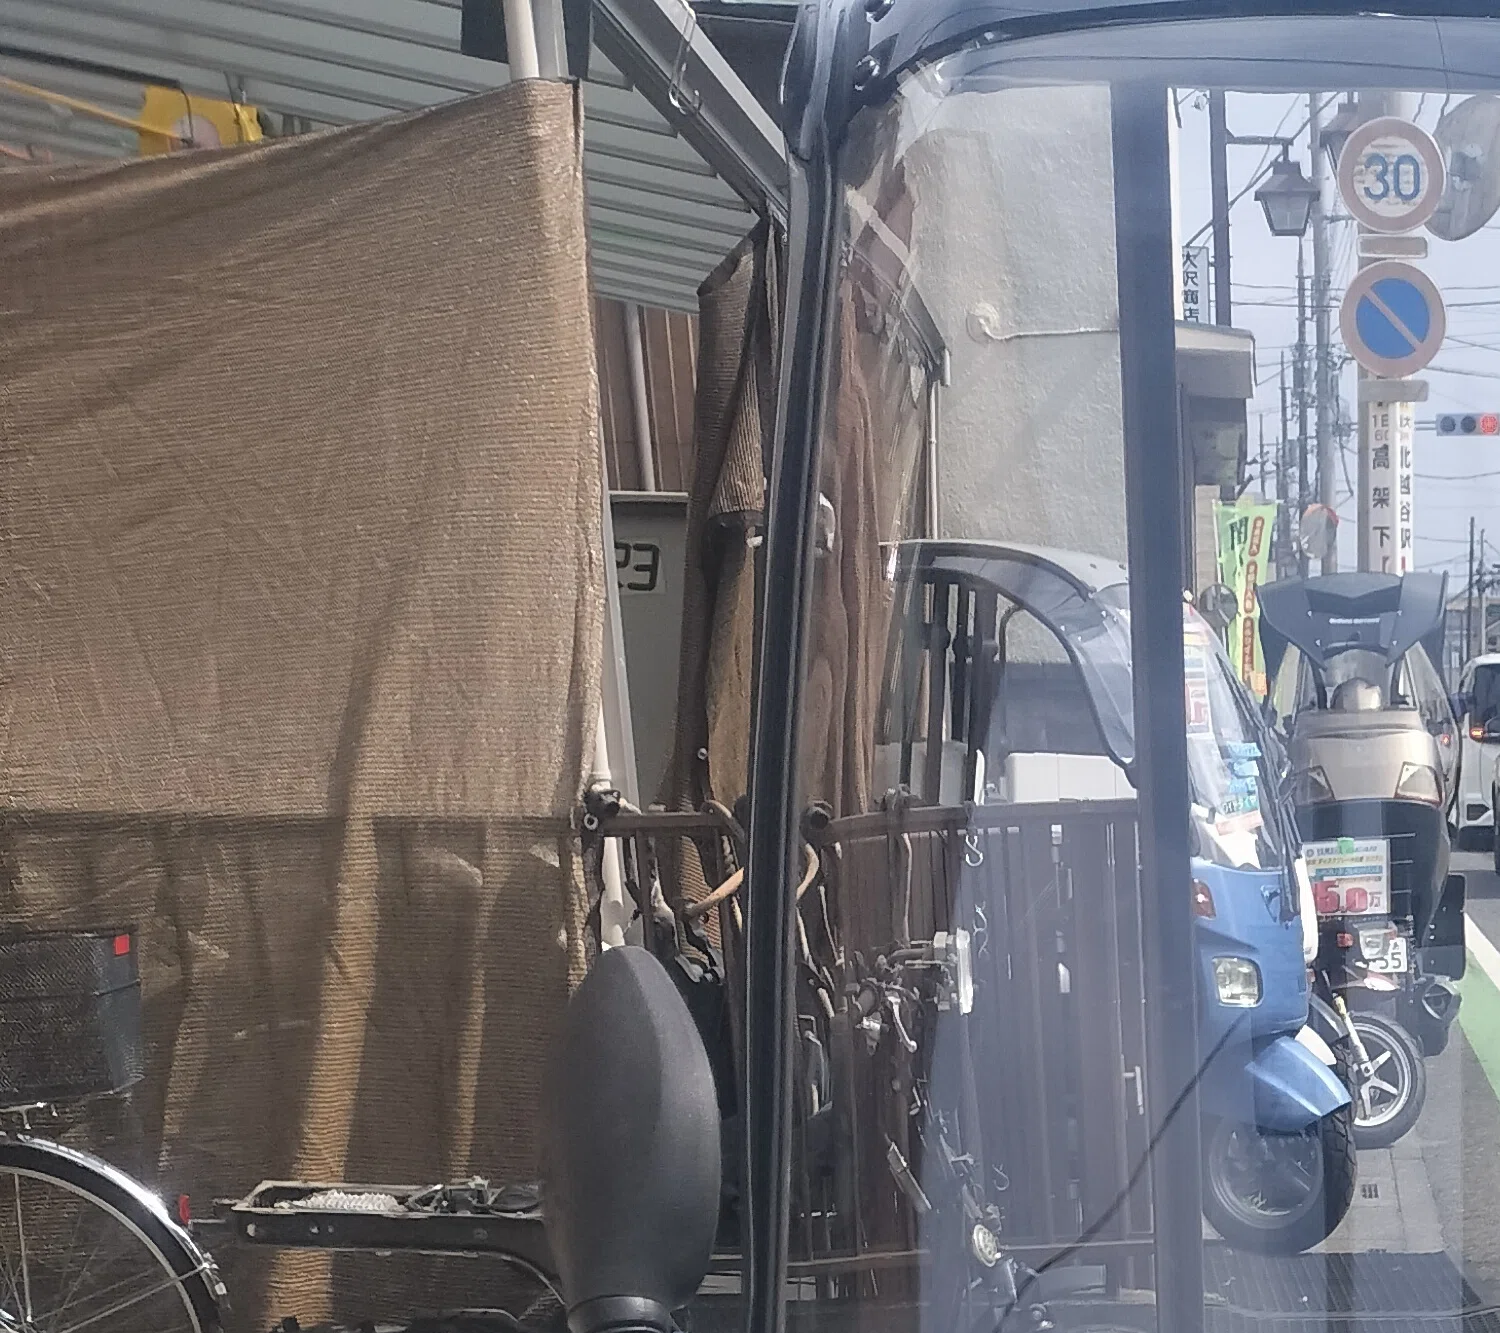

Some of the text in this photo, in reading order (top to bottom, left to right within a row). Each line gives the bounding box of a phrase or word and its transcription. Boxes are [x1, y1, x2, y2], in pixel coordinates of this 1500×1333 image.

[1363, 153, 1420, 201] 30
[1372, 443, 1390, 548] 高架下
